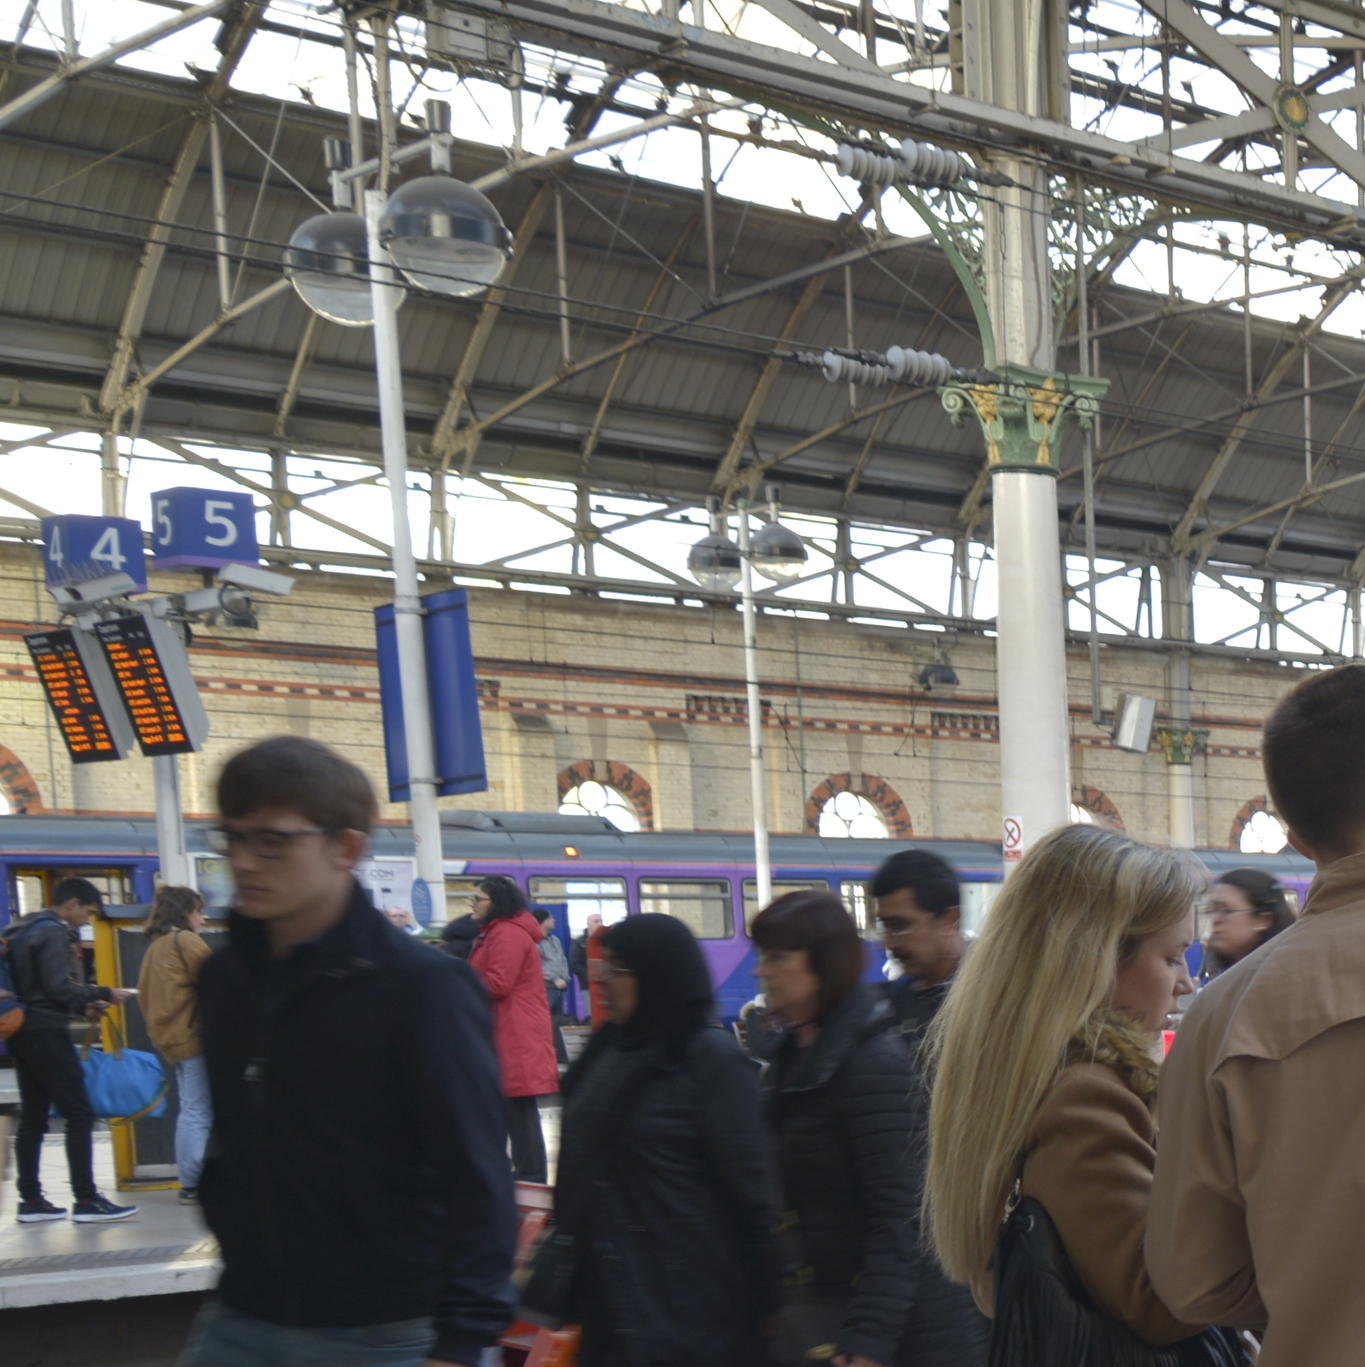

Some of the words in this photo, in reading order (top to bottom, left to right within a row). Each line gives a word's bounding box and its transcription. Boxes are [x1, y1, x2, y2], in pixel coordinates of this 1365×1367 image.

[157, 499, 172, 546] 5
[205, 500, 238, 547] 5
[50, 525, 63, 568] 4
[90, 527, 127, 570] 4
